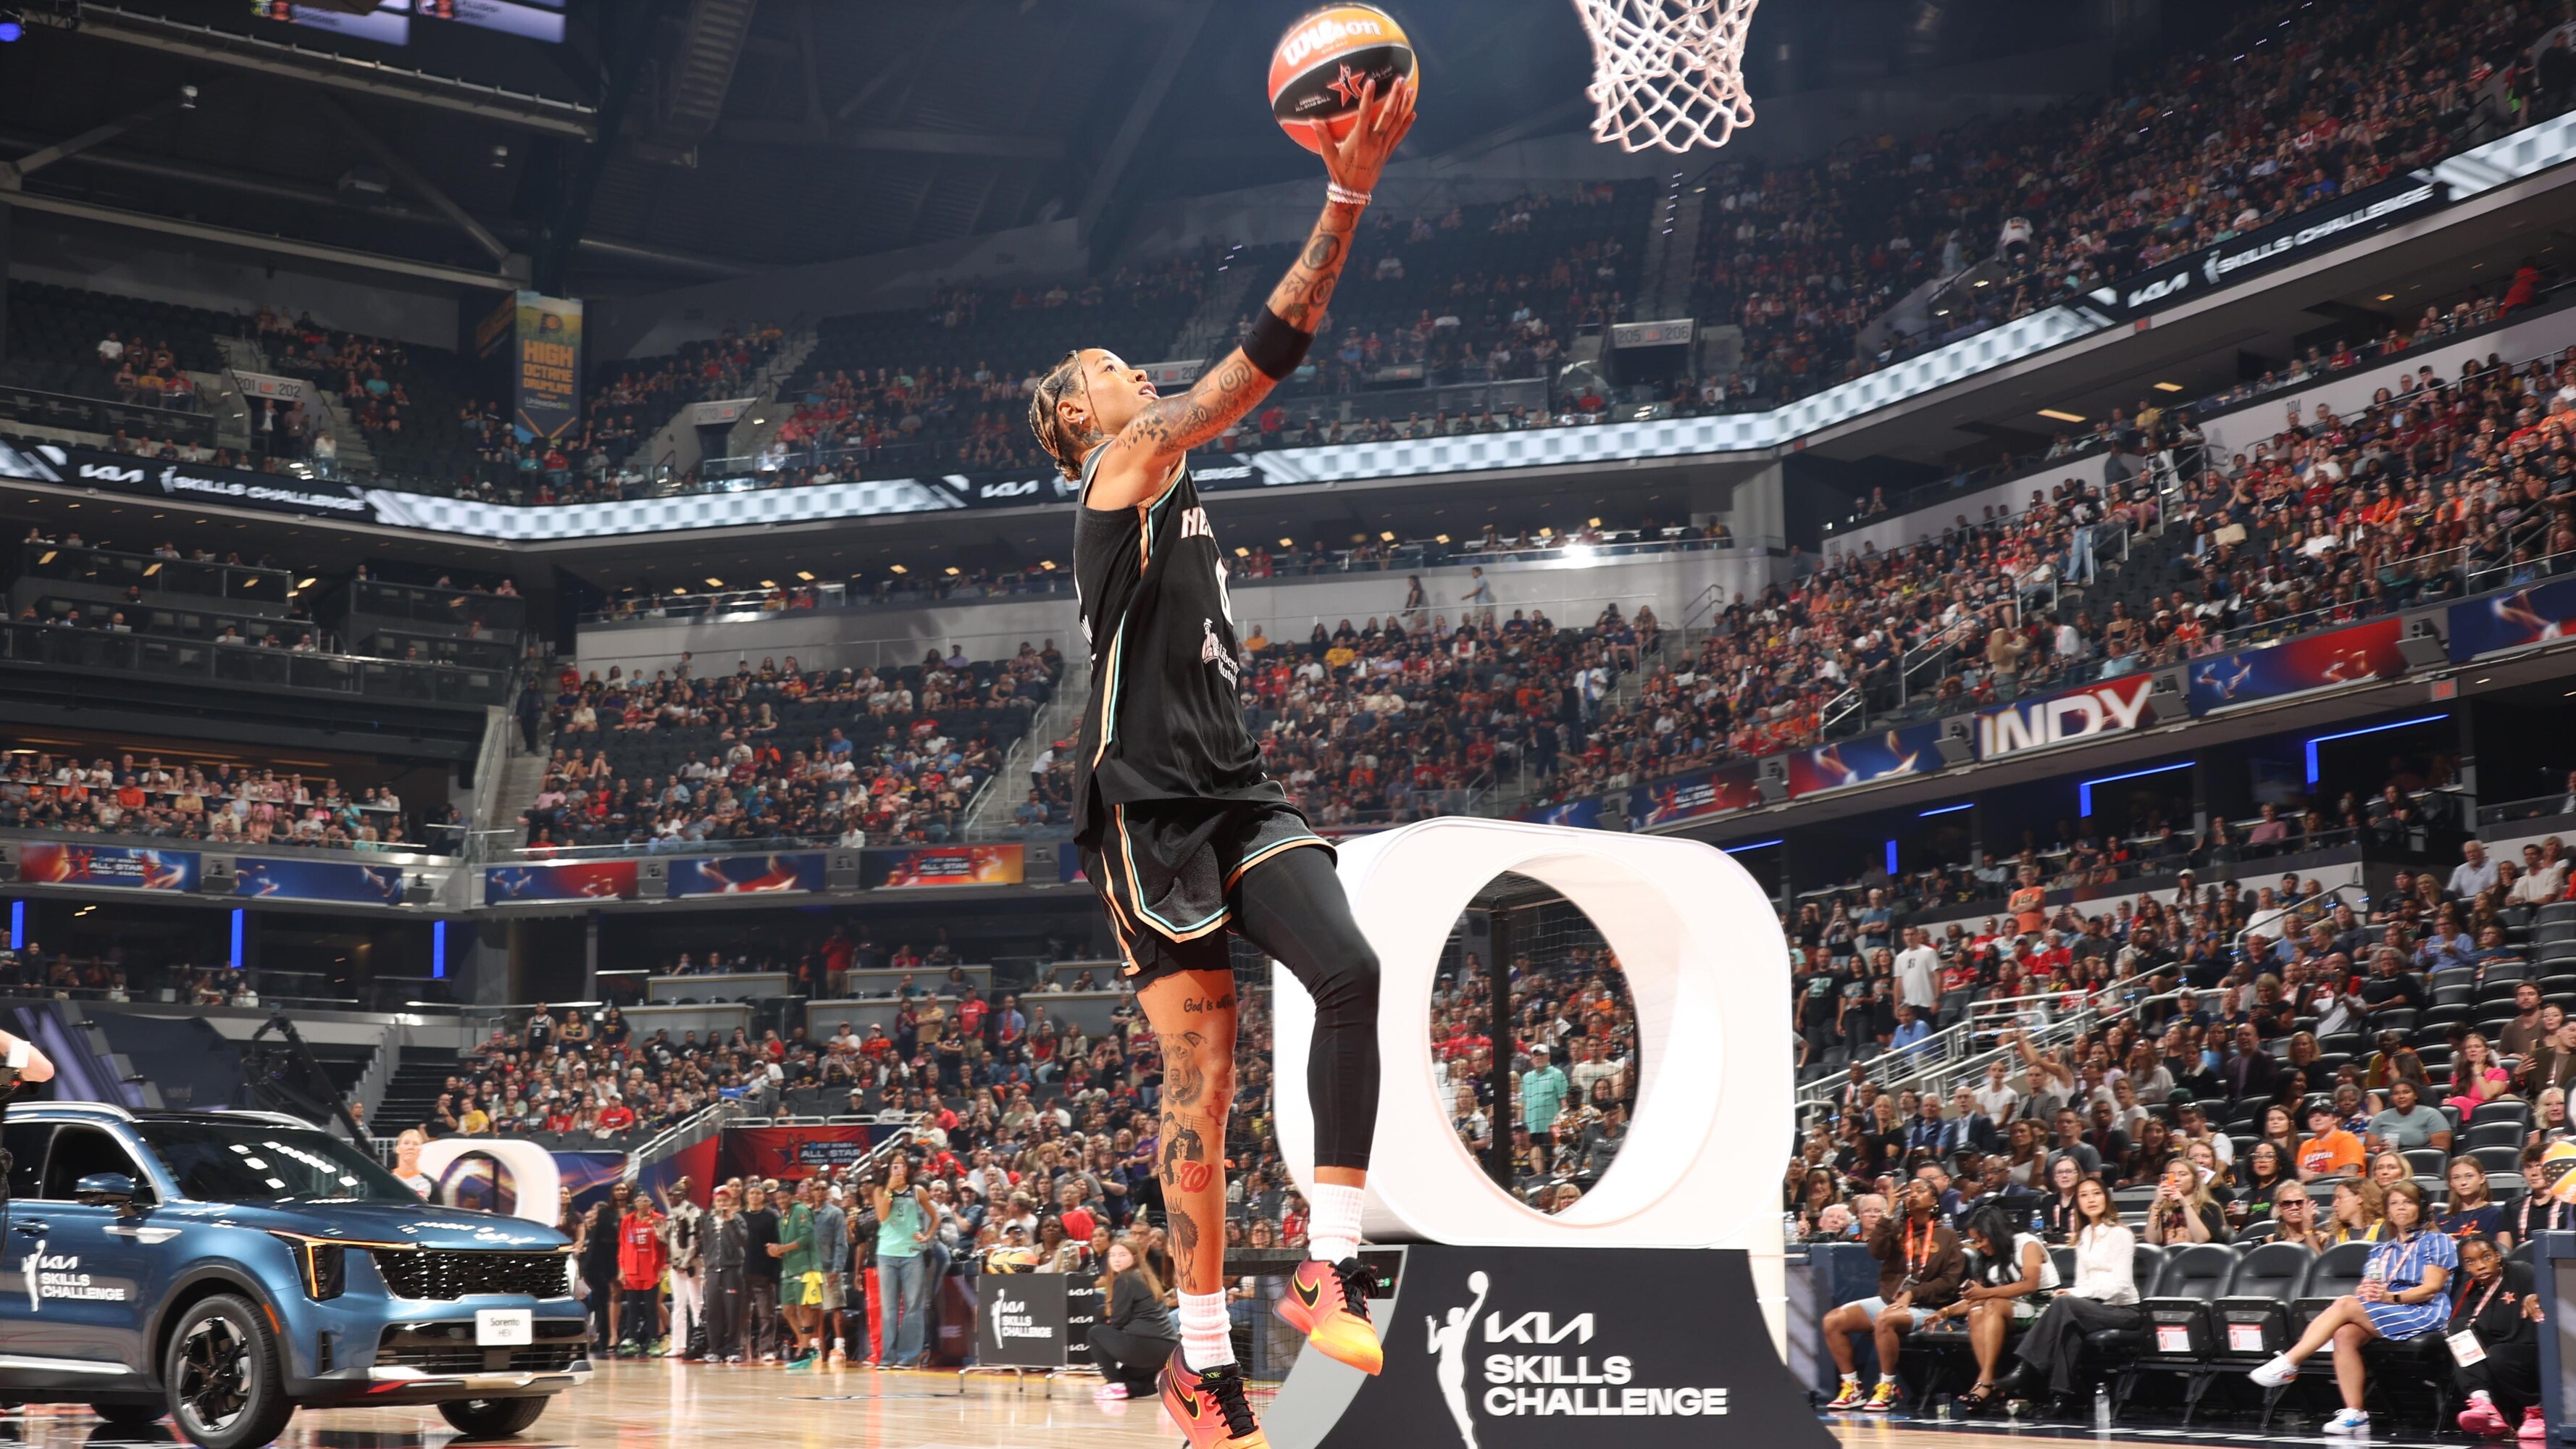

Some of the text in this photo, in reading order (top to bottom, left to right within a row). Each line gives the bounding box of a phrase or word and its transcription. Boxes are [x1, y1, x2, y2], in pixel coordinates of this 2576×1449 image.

[1282, 20, 1383, 67] Wilson
[2217, 235, 2295, 275] SKILLS
[2294, 183, 2433, 246] CHALLENGE
[523, 338, 574, 369] HIGH
[522, 363, 574, 383] OCTANE
[277, 383, 301, 398] 202
[522, 377, 574, 395] DRUMLINE
[173, 475, 246, 496] SKILLS
[246, 486, 365, 511] CHALLENGE
[1218, 643, 1240, 677] Liberty
[1981, 679, 2153, 761] INDY
[88, 861, 145, 872] ALL STAR
[1183, 997, 1204, 1014] God
[1206, 1000, 1213, 1011] is
[800, 1148, 862, 1158] ALL STAR
[39, 1255, 79, 1270] KIA
[40, 1271, 91, 1287] SKILLS
[41, 1285, 126, 1302] CHALLENGE
[490, 1317, 521, 1327] Sorento
[1001, 1315, 1033, 1327] SKILLS
[1484, 1311, 1594, 1345] KIA
[498, 1329, 513, 1337] HEV
[1001, 1327, 1053, 1338] CHALLENGE
[1484, 1354, 1633, 1385] SKILLS
[1483, 1387, 1730, 1416] CHALLENGE
